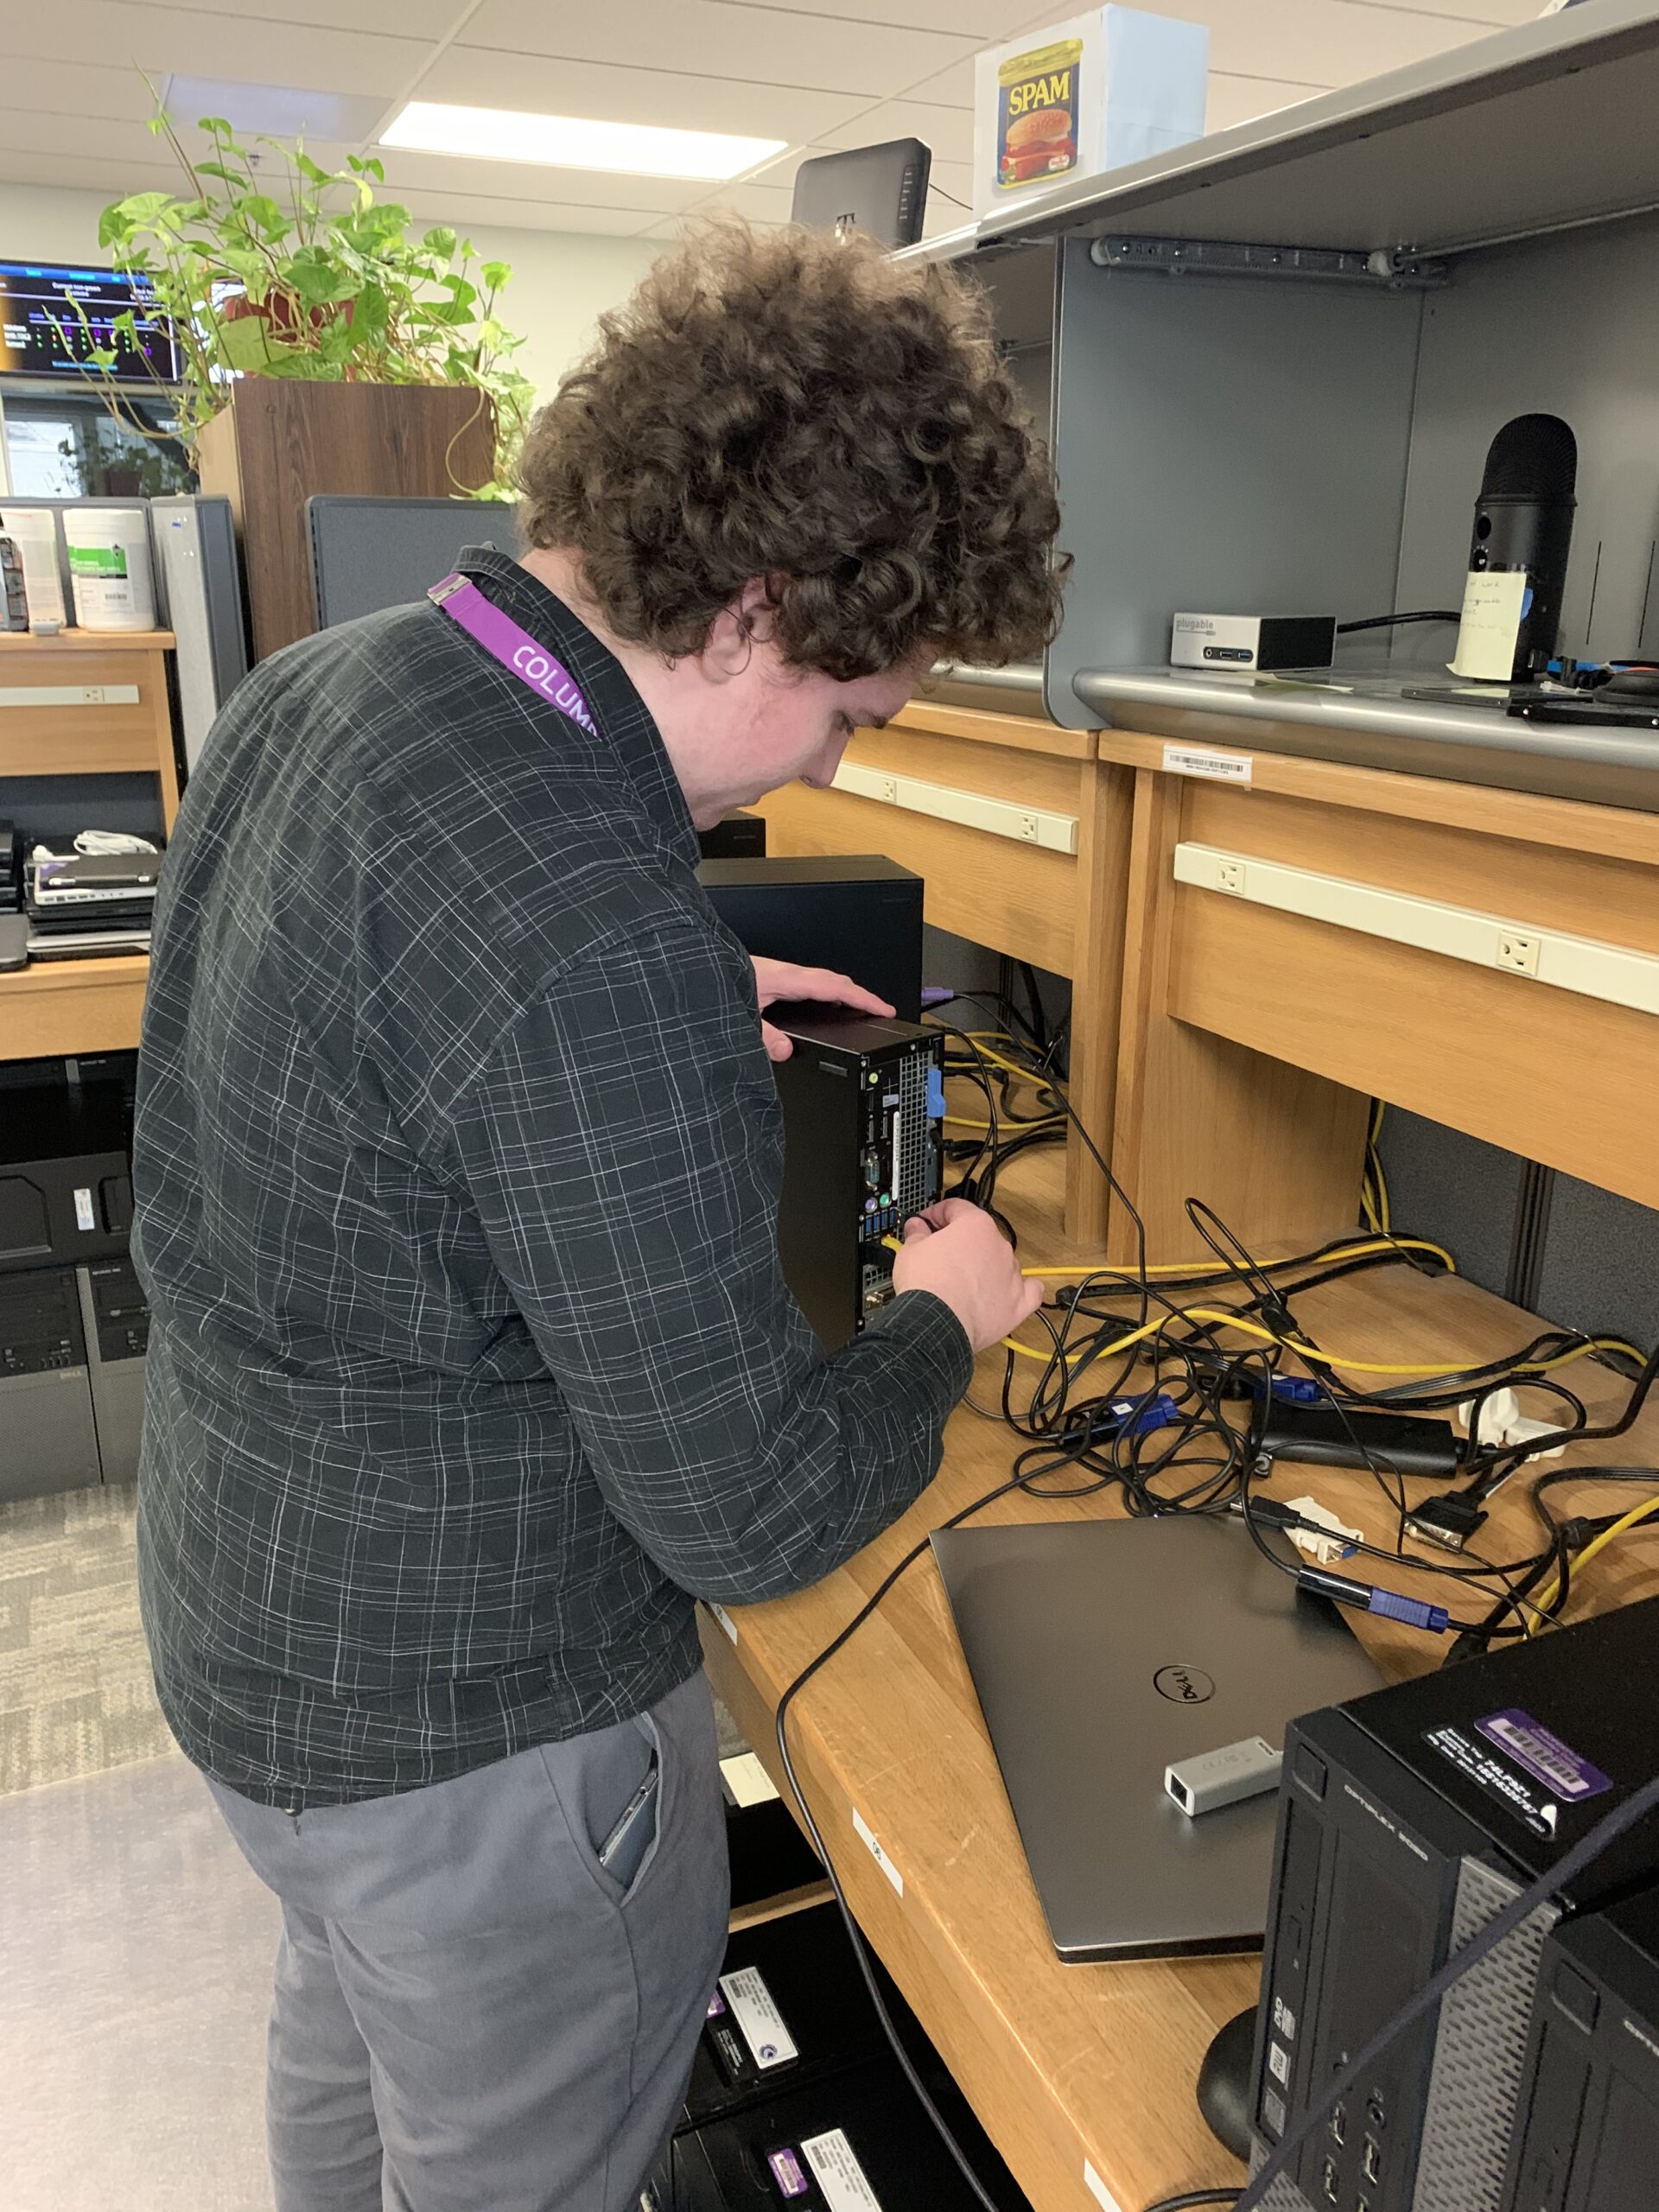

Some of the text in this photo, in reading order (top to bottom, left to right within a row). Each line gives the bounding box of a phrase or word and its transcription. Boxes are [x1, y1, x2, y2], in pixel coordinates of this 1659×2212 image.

[1008, 71, 1071, 116] SPAM
[1176, 618, 1214, 630] plugable
[1172, 1669, 1198, 1700] DELL
[1344, 1783, 1396, 1834] OPTIPLEX
